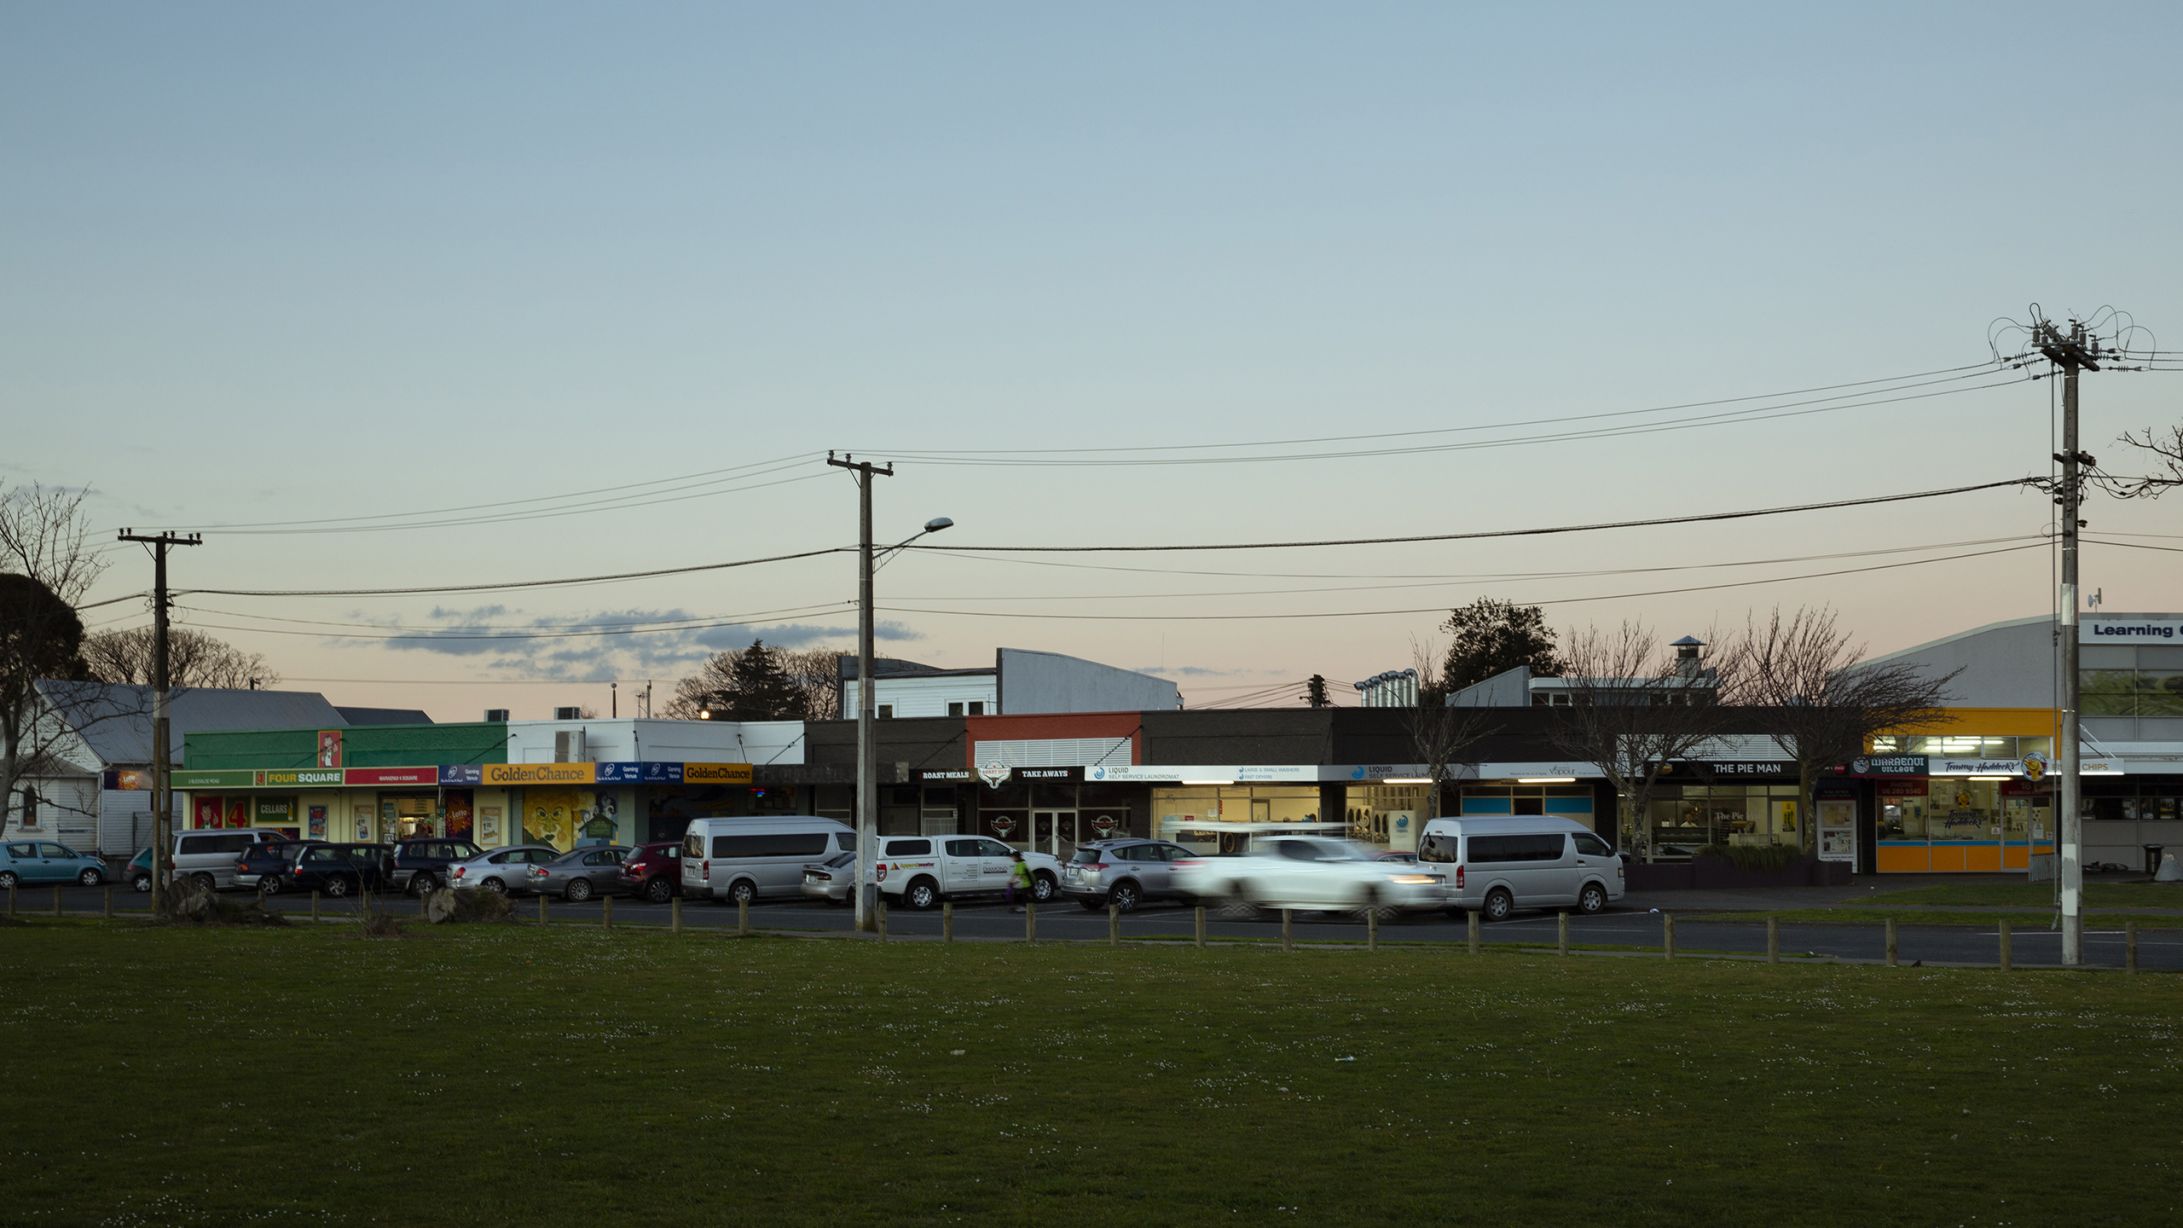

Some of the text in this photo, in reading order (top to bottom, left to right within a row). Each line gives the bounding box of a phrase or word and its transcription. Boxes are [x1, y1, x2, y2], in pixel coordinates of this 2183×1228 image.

[2093, 624, 2173, 638] Learning
[1368, 766, 1392, 774] LIQUID
[1713, 764, 1782, 773] THE PIE MAN
[2082, 763, 2109, 771] CHIPS
[490, 766, 585, 781] GoldenChance
[686, 767, 751, 779] GoldenChance
[923, 771, 969, 779] ROAST MEALS
[1022, 770, 1069, 778] TAKE AWAYS
[269, 773, 341, 783] FOUR SQUARE
[260, 804, 288, 814] CELLARS
